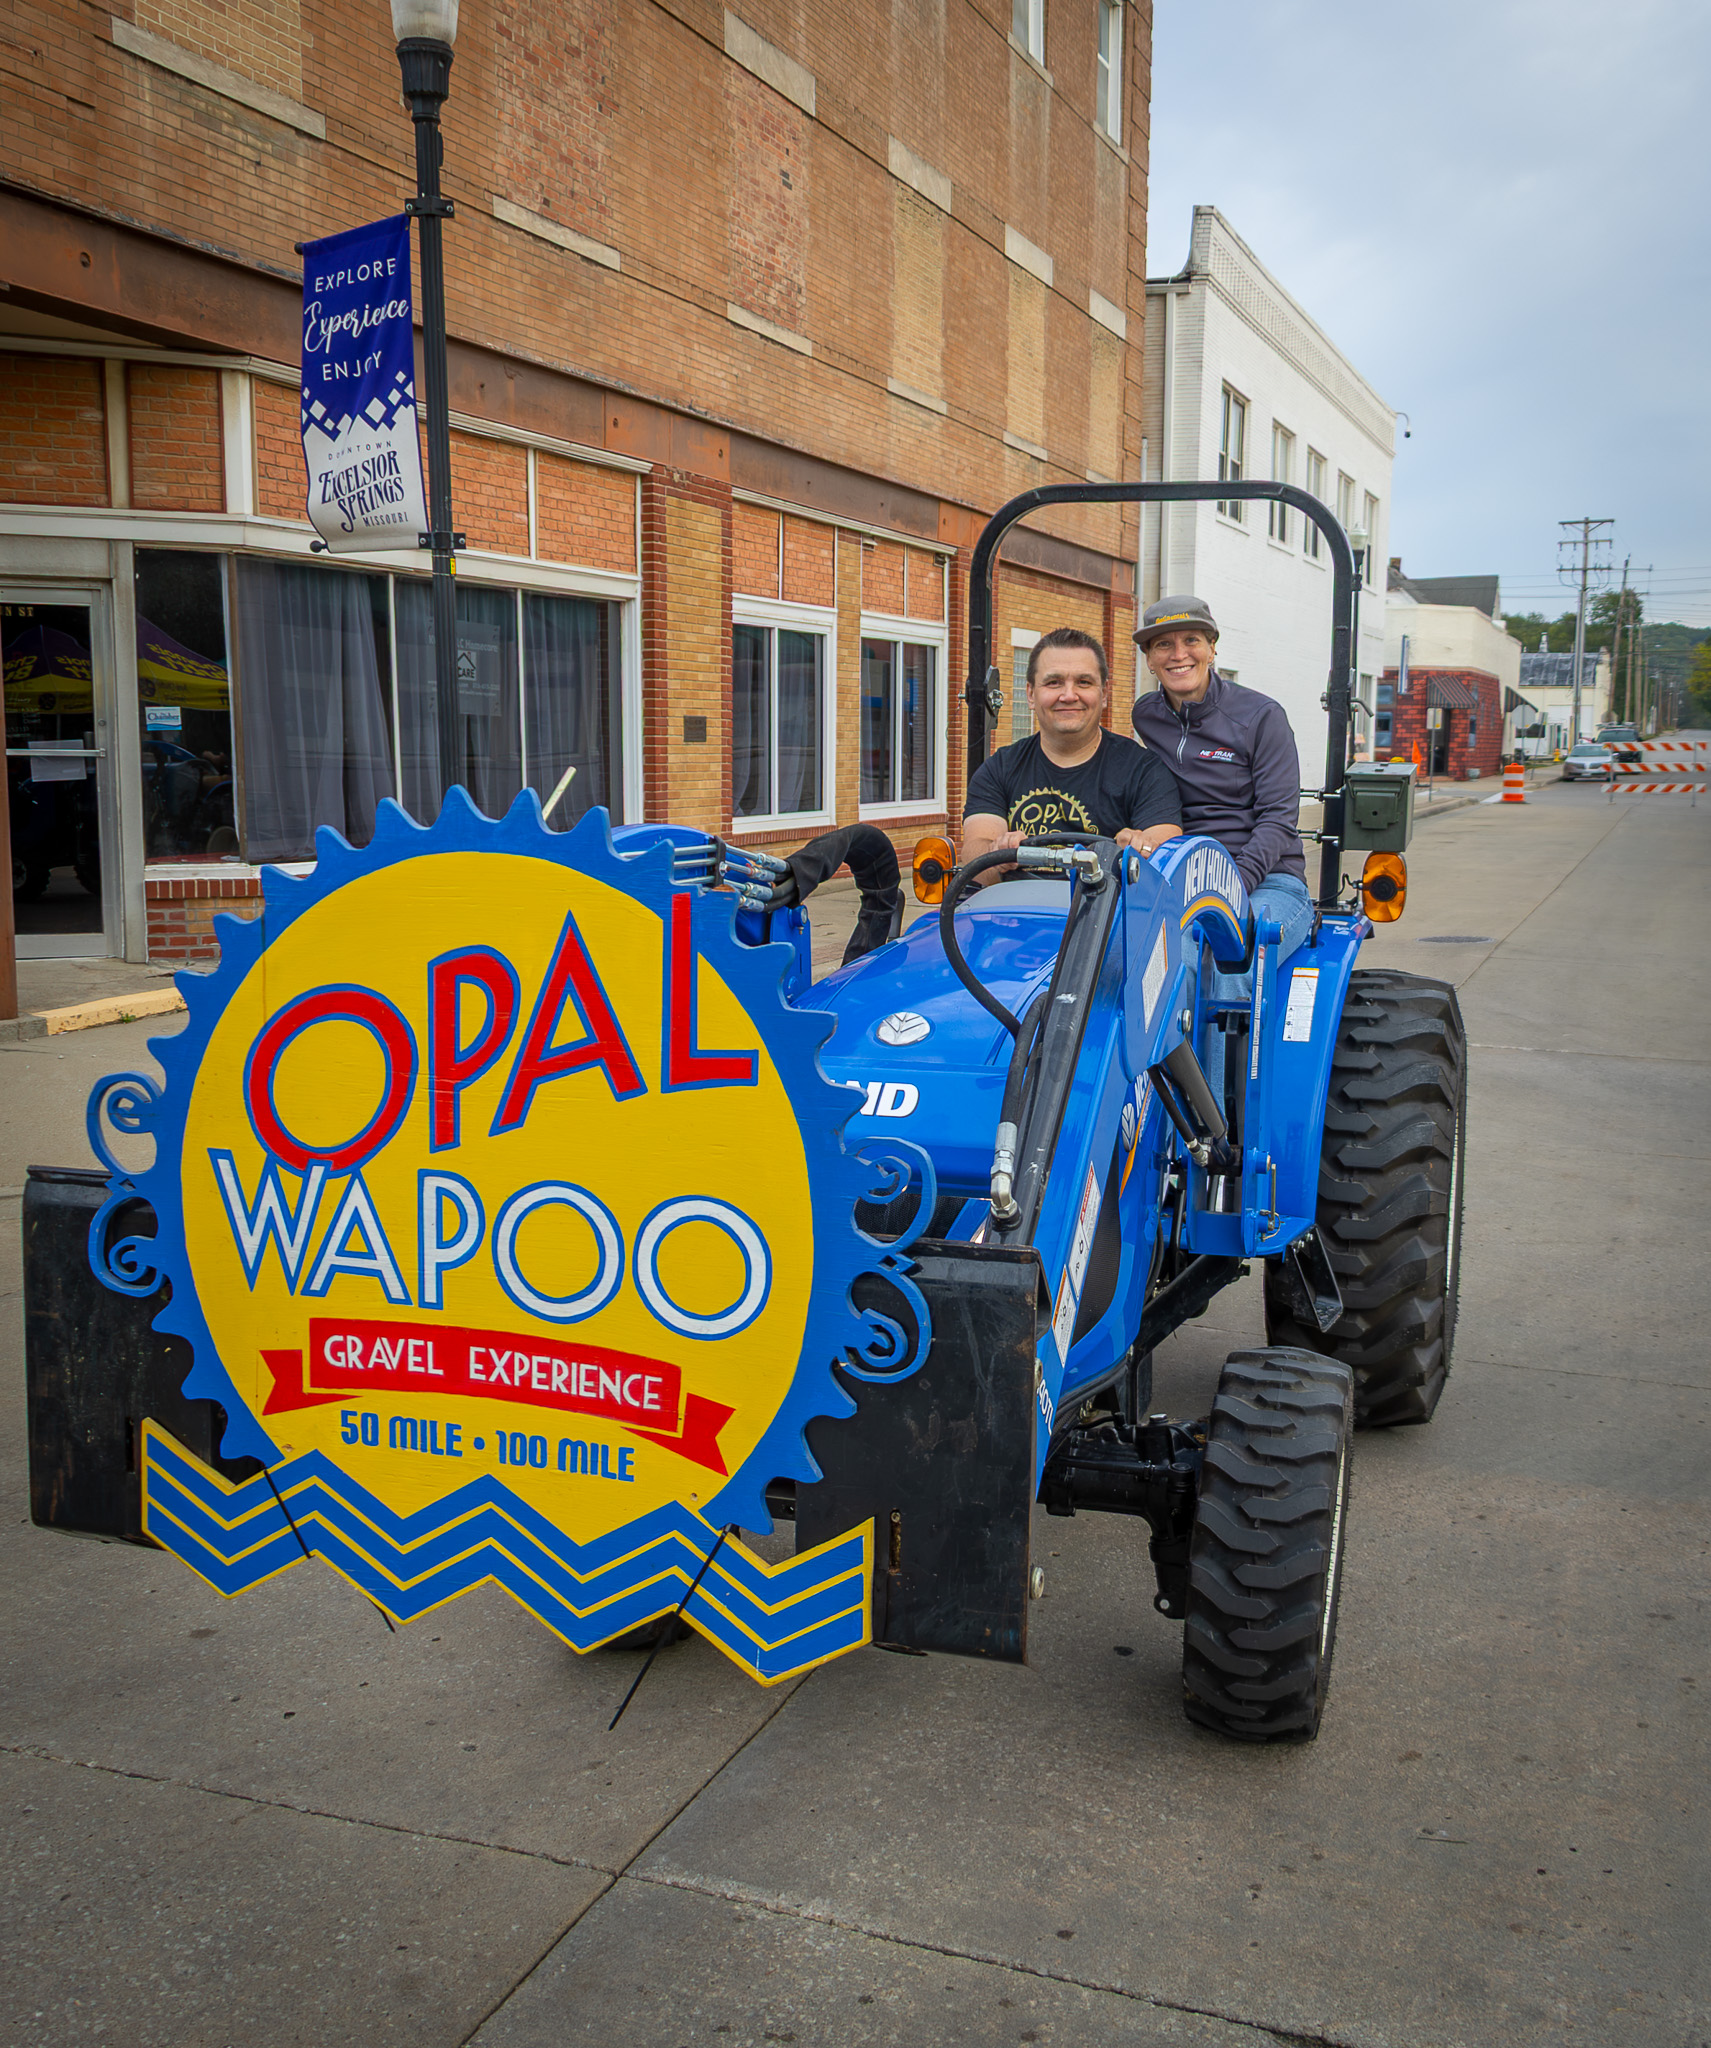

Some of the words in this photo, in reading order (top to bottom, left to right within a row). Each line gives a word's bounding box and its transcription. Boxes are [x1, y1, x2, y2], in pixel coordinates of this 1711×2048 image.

[315, 258, 396, 293] EXPLORE
[304, 299, 409, 354] Experience
[318, 450, 401, 505] EXCELSIOR
[337, 476, 405, 533] SPRINGS
[362, 511, 409, 528] MISSOURI
[1021, 802, 1080, 824] OPAL
[1183, 846, 1208, 908] NEW
[1206, 848, 1242, 919] HOLLAND
[243, 892, 759, 1178] OPAL
[208, 1147, 772, 1341] WAPOO
[323, 1335, 444, 1376] GRAVEL
[469, 1346, 663, 1410] EXPERIENCE
[340, 1409, 379, 1447] 50
[389, 1416, 463, 1458] MILE
[495, 1429, 548, 1469] 100
[557, 1437, 635, 1482] MILE
